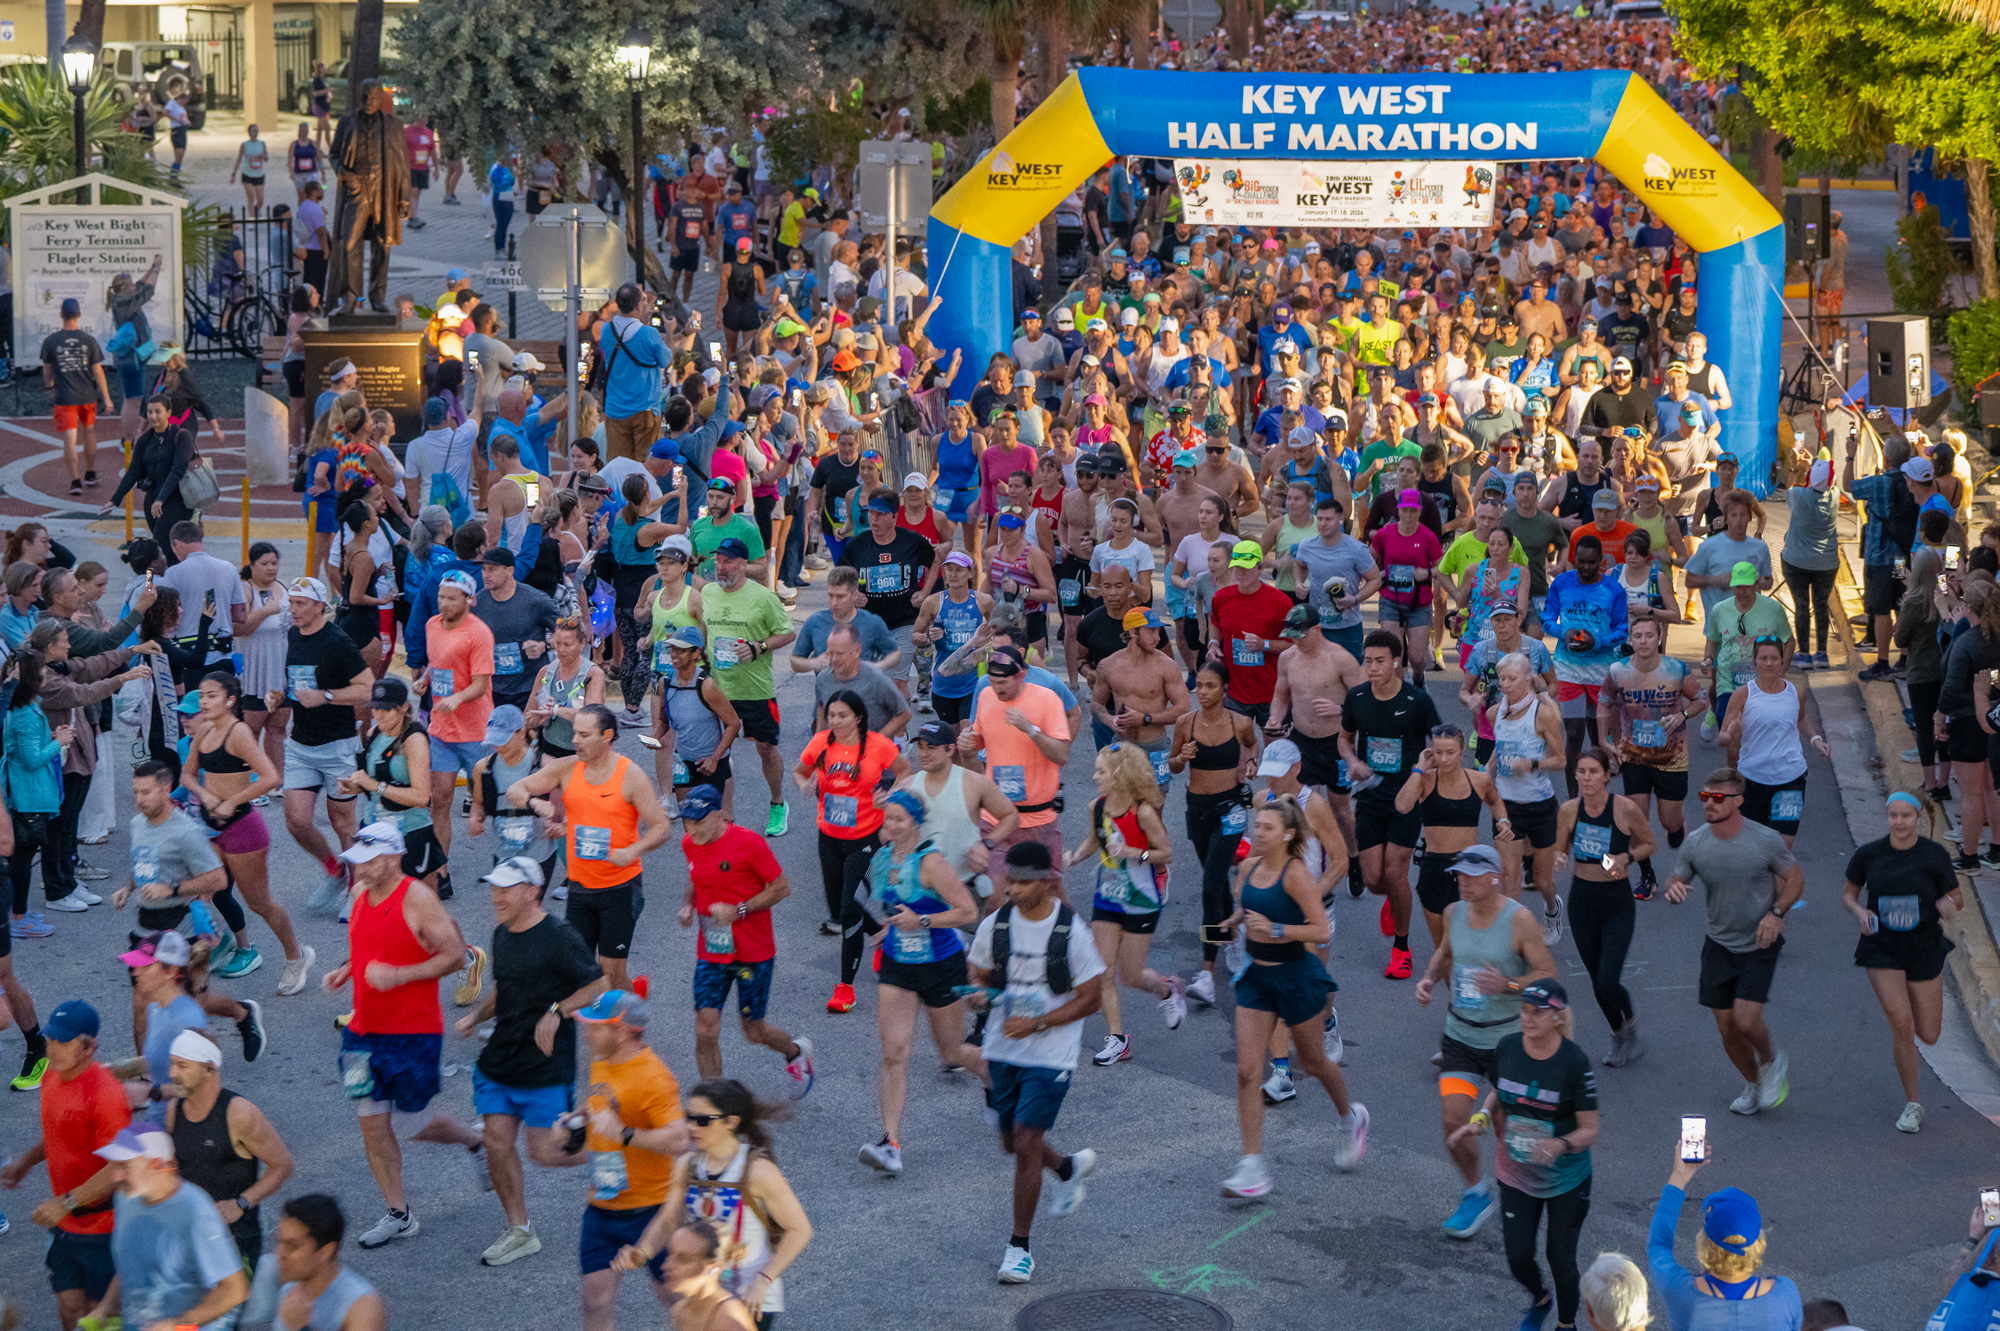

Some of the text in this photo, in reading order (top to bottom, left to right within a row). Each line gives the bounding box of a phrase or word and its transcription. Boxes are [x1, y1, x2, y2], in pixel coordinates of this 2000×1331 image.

[1242, 85, 1451, 115] KEY WEST
[1168, 122, 1538, 151] HALF MARATHON
[1016, 163, 1063, 175] WEST
[1672, 168, 1716, 179] WEST
[988, 174, 1020, 185] KEY
[1644, 178, 1676, 190] KEY
[1326, 182, 1373, 194] WEST
[1296, 194, 1330, 206] KEY
[45, 219, 146, 232] Key West Bight
[46, 235, 145, 247] Ferry Terminal
[48, 253, 146, 265] Flagler Station
[1382, 286, 1395, 297] 2:00
[877, 577, 895, 589] 960
[707, 618, 748, 627] BrewRunners
[951, 632, 970, 643] 1310
[1237, 652, 1258, 663] 1201
[1371, 751, 1396, 764] 4575
[1779, 806, 1798, 817] 551
[1581, 839, 1601, 855] 332
